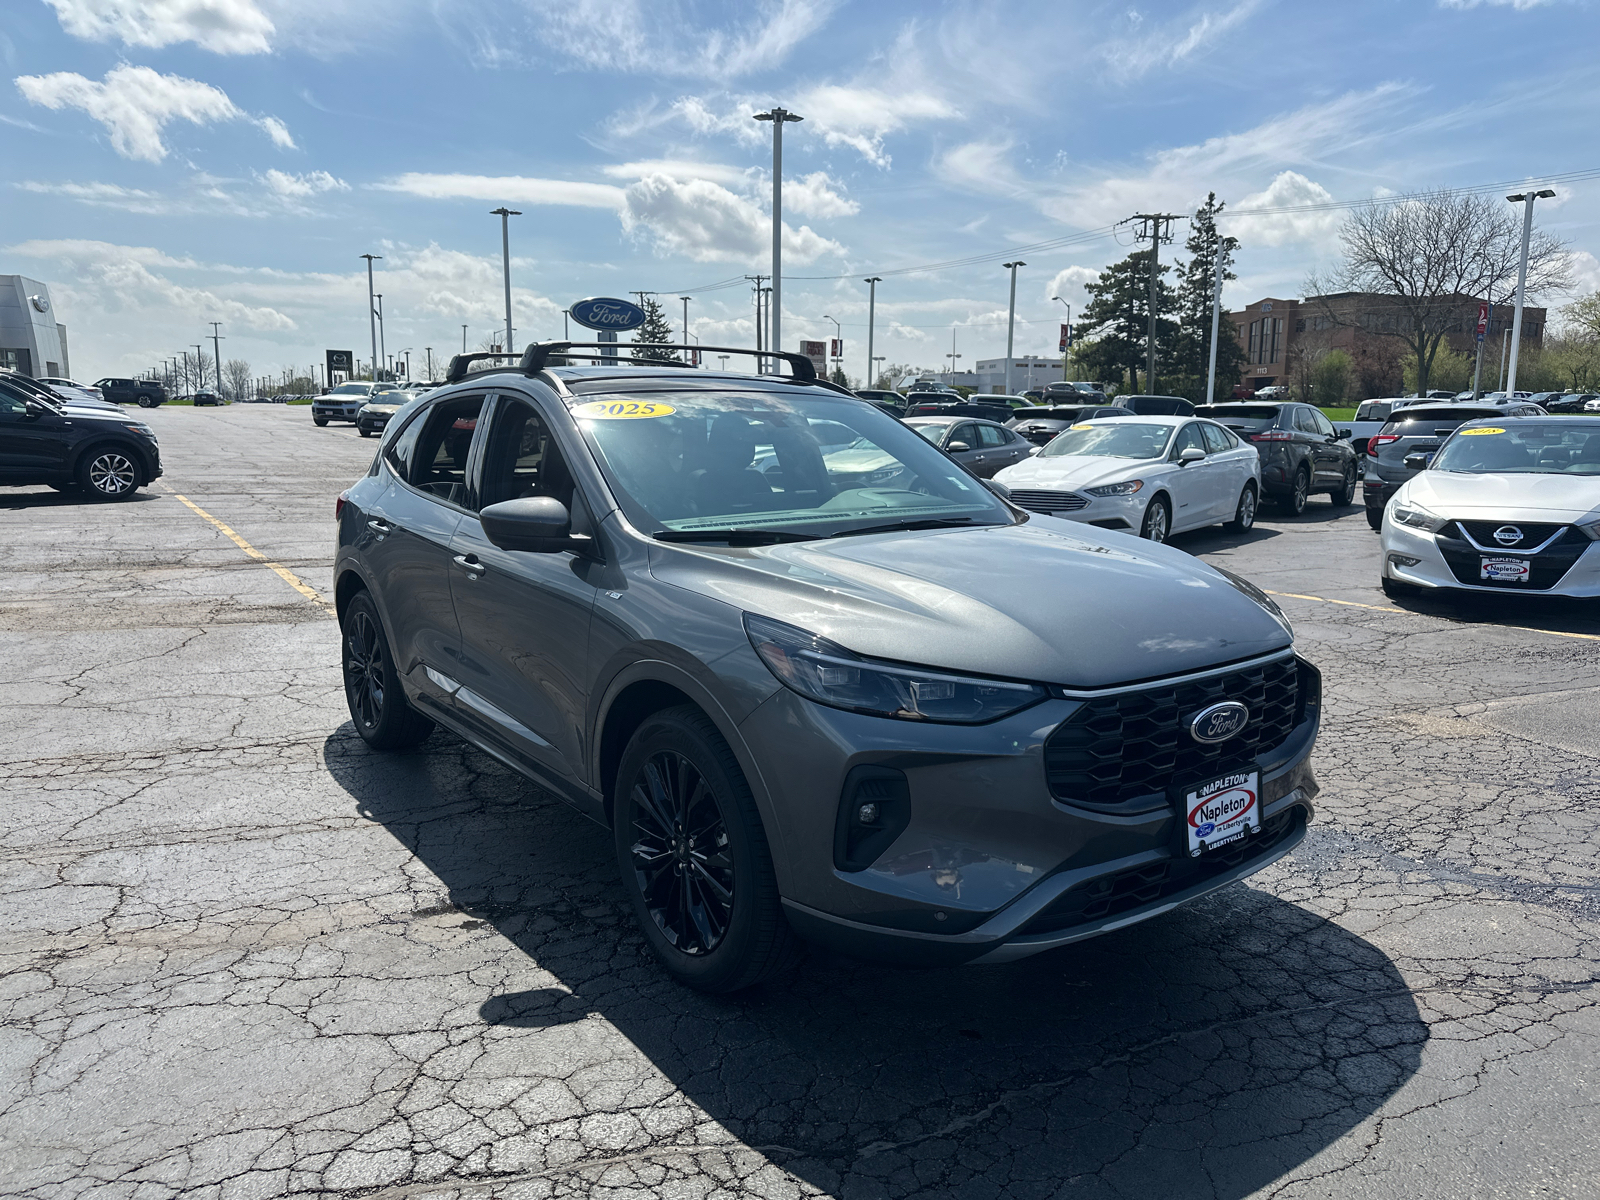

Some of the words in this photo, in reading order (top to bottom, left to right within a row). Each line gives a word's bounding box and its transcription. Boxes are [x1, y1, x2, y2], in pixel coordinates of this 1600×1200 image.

[589, 303, 632, 324] Ford
[594, 403, 657, 416] 2025
[1490, 565, 1521, 573] Napleton
[1207, 710, 1239, 736] Ford
[1203, 774, 1246, 796] NAPLETON
[1200, 798, 1245, 823] Napleton
[1199, 825, 1213, 836] Ford
[1222, 816, 1252, 831] Libertyville
[1208, 831, 1245, 851] LIBERTYVILLE
